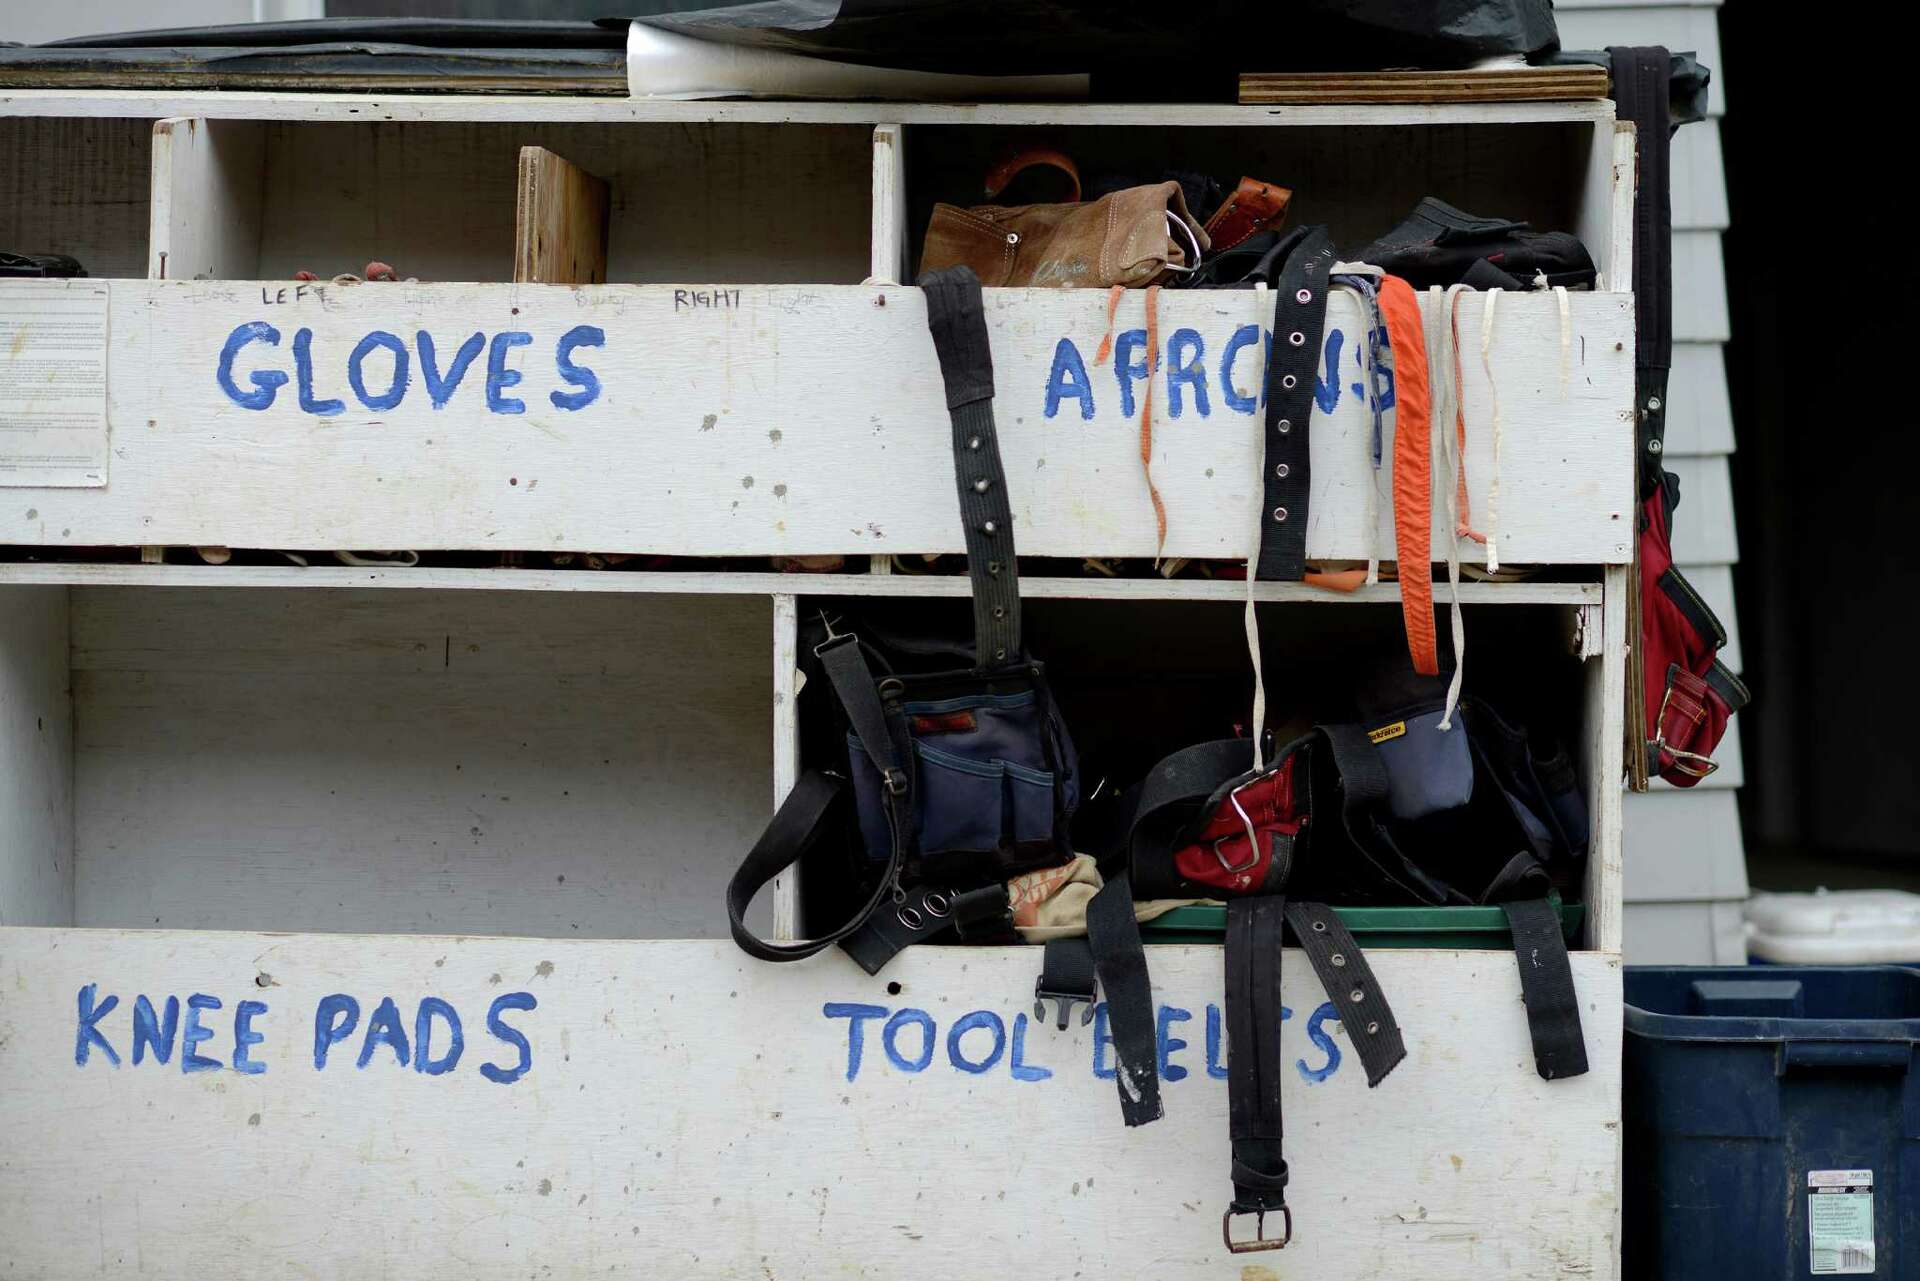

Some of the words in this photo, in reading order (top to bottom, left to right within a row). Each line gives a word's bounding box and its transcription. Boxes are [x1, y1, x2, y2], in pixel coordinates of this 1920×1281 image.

[262, 284, 326, 304] LEFT
[674, 289, 741, 312] RIGHT
[217, 321, 605, 416] GLOVES
[75, 983, 268, 1075] KNEE
[314, 992, 536, 1084] PADS
[823, 1002, 1053, 1082] TOOL
[1092, 1002, 1342, 1084] BELS
